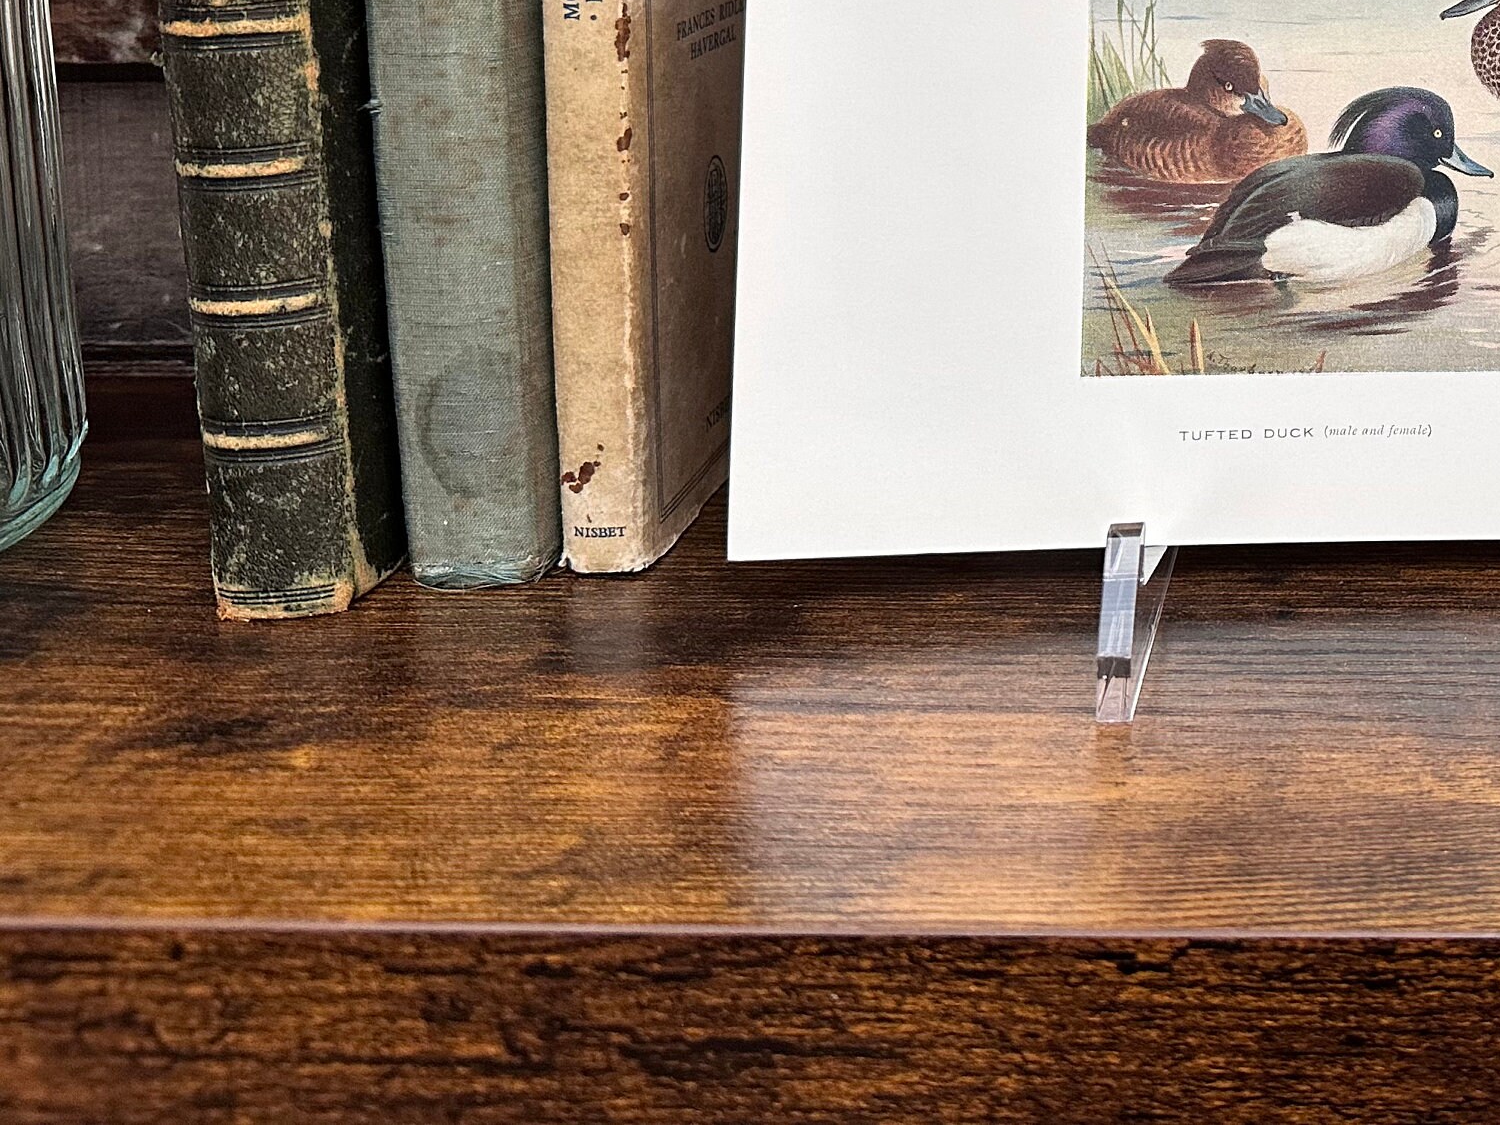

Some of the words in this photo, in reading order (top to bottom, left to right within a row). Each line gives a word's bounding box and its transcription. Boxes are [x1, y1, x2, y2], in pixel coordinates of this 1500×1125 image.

[676, 7, 716, 42] FRANCES
[690, 24, 737, 61] HAVERGAL
[1178, 428, 1253, 442] TUFTED
[1263, 426, 1315, 440] DUCK
[1324, 423, 1357, 439] (male
[1361, 424, 1385, 437] and
[1386, 423, 1433, 440] female)
[573, 525, 627, 538] NISBET
